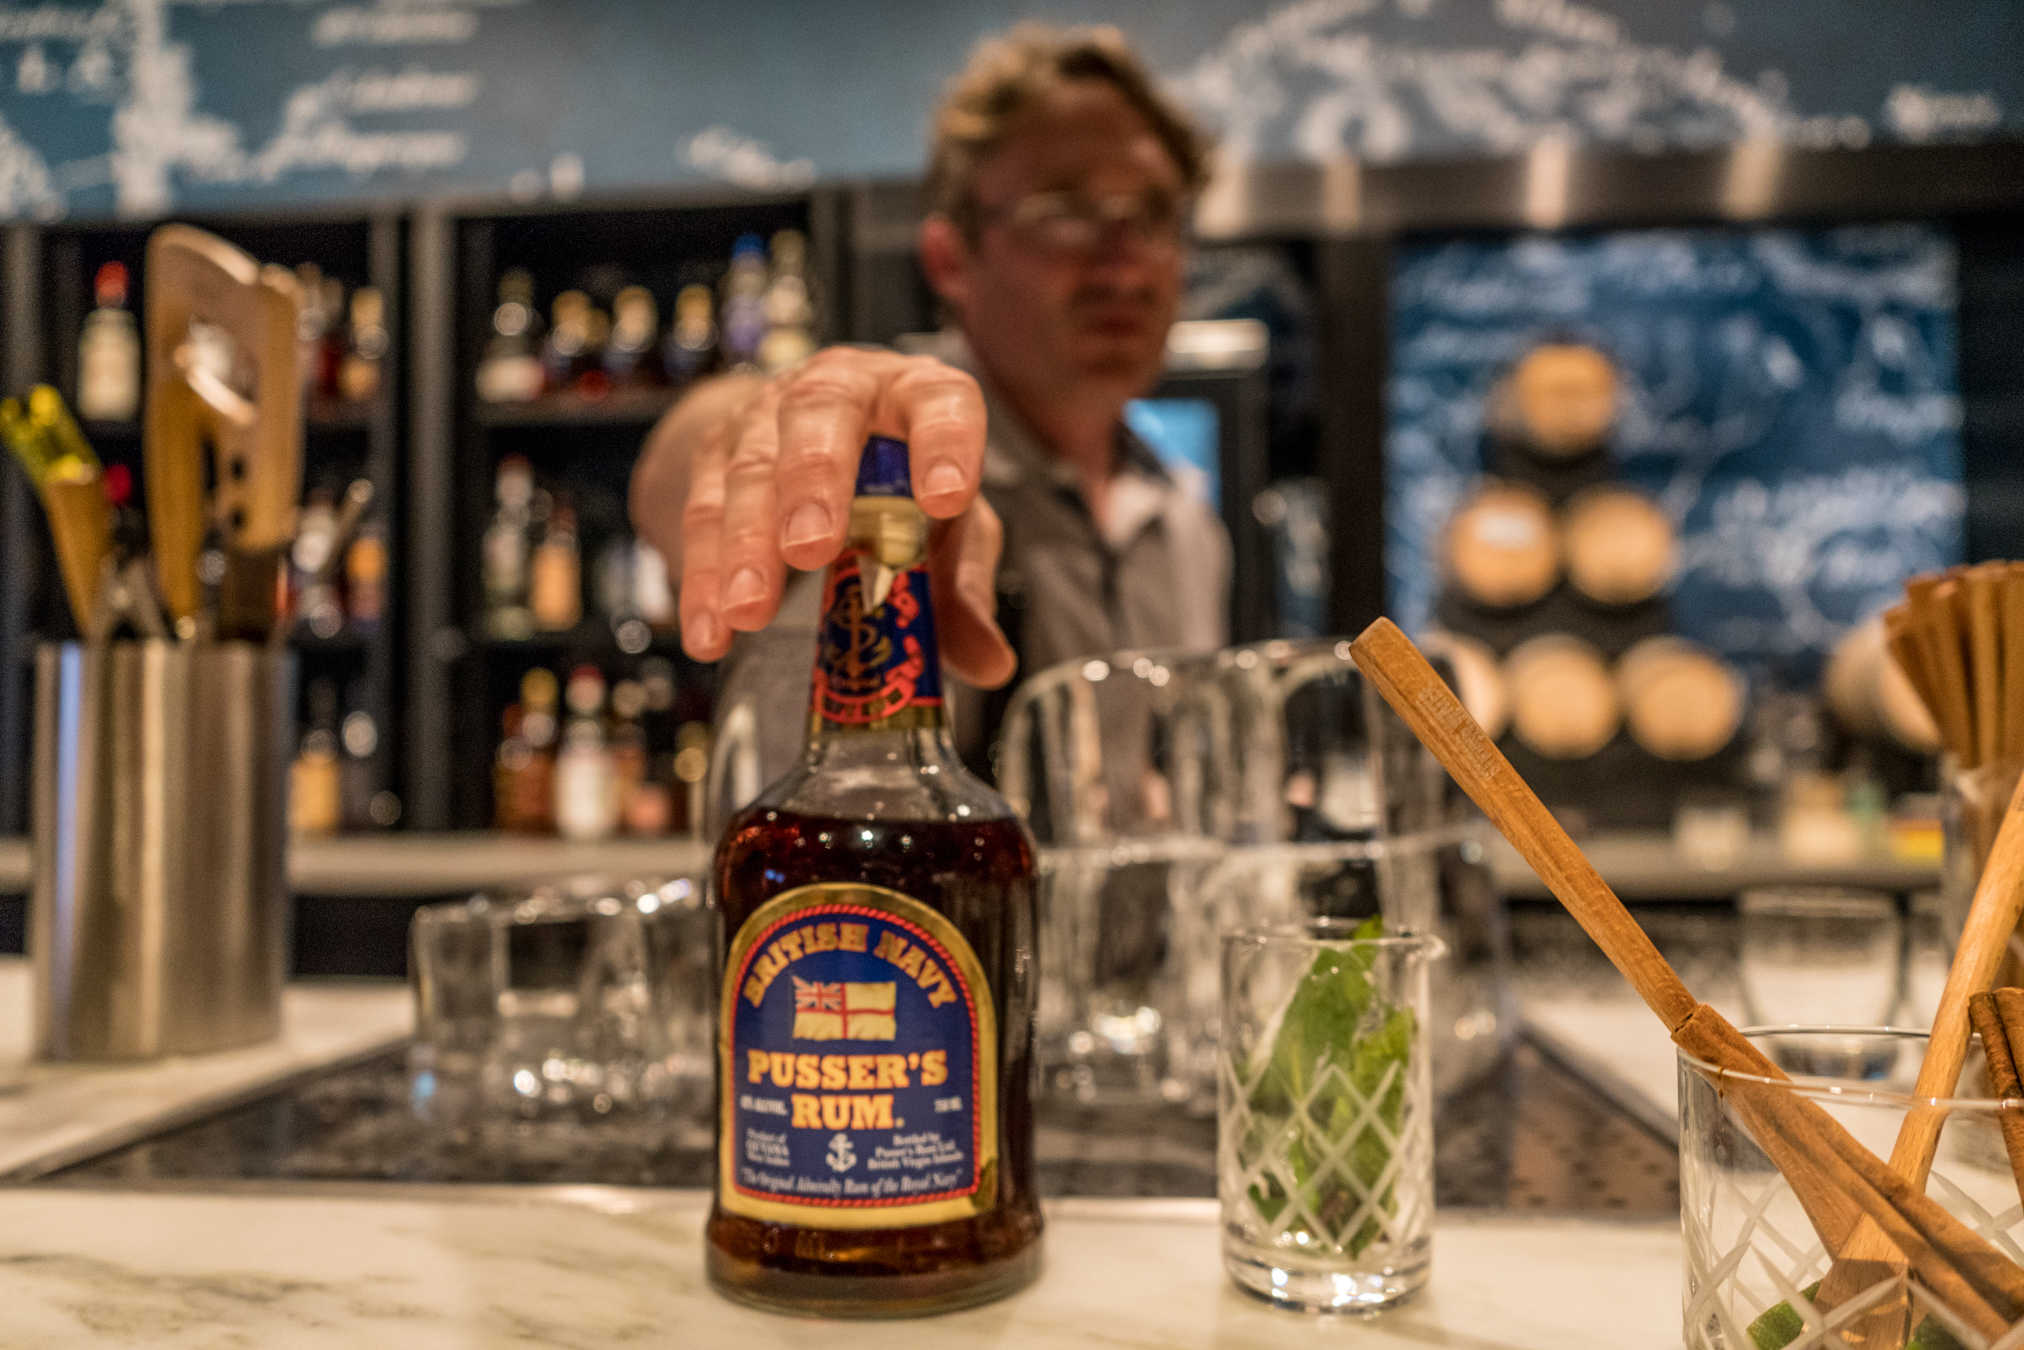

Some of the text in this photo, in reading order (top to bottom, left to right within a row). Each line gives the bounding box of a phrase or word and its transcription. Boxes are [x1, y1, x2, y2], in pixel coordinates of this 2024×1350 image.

[743, 922, 957, 1009] BRITISH NAVY
[747, 1049, 949, 1090] PUSSER'S
